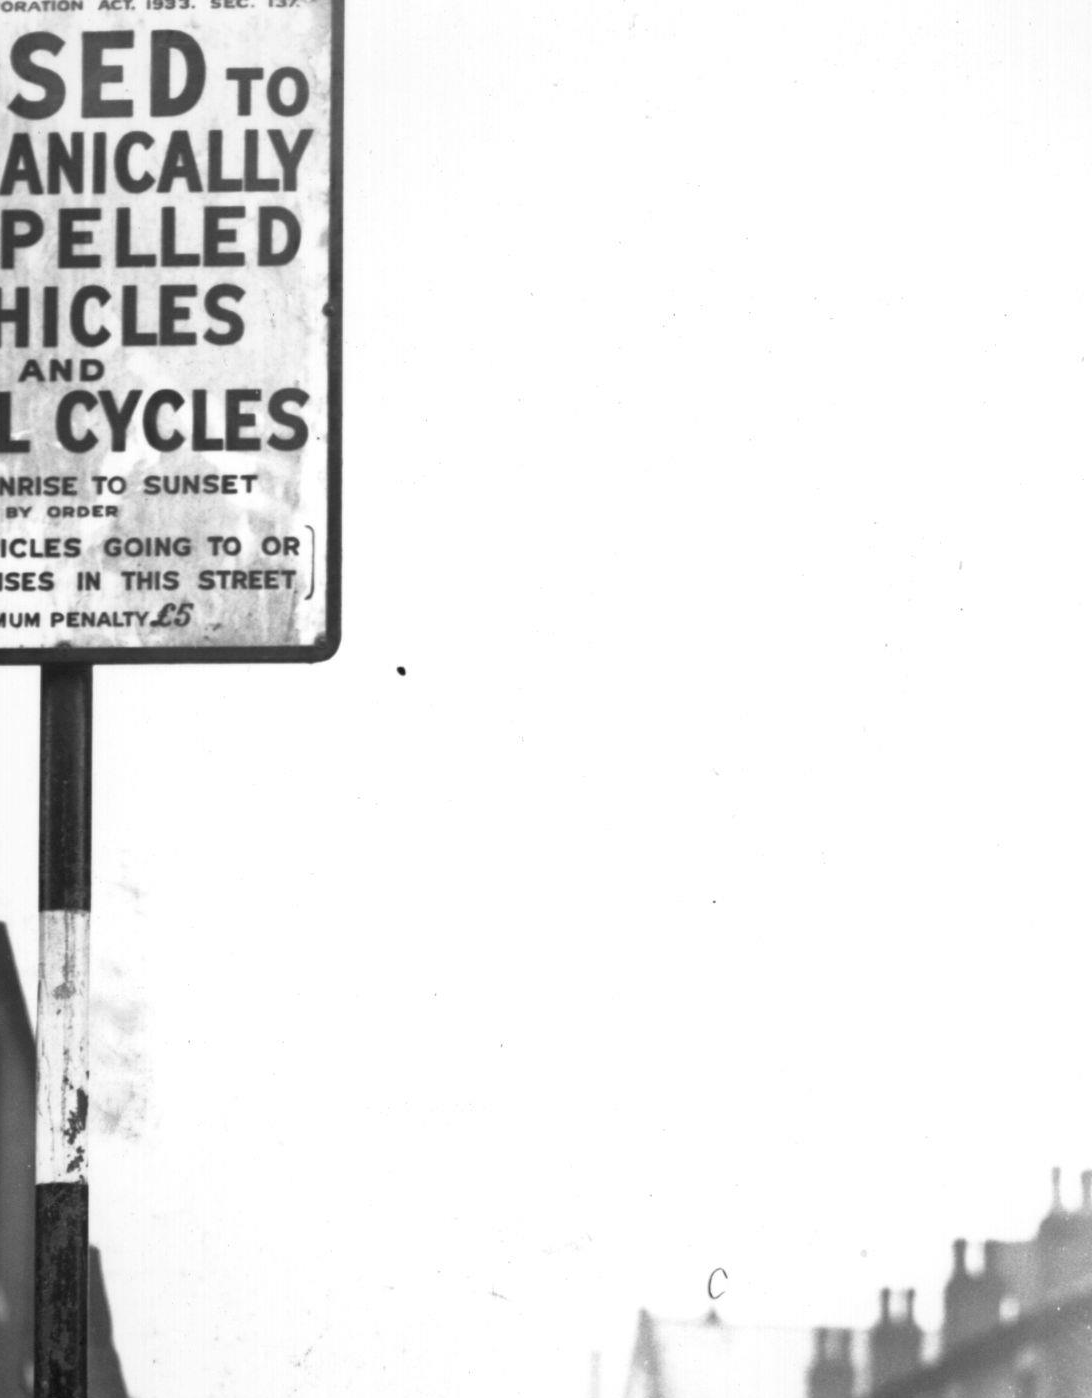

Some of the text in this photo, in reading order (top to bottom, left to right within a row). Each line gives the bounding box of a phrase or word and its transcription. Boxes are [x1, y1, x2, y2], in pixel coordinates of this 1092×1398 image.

[226, 66, 310, 117] TO
[17, 358, 105, 383] AND
[55, 387, 310, 455] CYCLES
[91, 475, 127, 495] TO
[143, 474, 259, 496] SUNSET
[5, 505, 119, 519] BY ORDER
[103, 536, 192, 558] GOING
[206, 535, 242, 557] TO
[261, 535, 300, 556] OR
[77, 571, 101, 592] IN
[120, 570, 180, 591] THIS
[197, 569, 298, 591] STREET
[50, 610, 149, 628] PENALTY
[149, 601, 195, 628] £5
